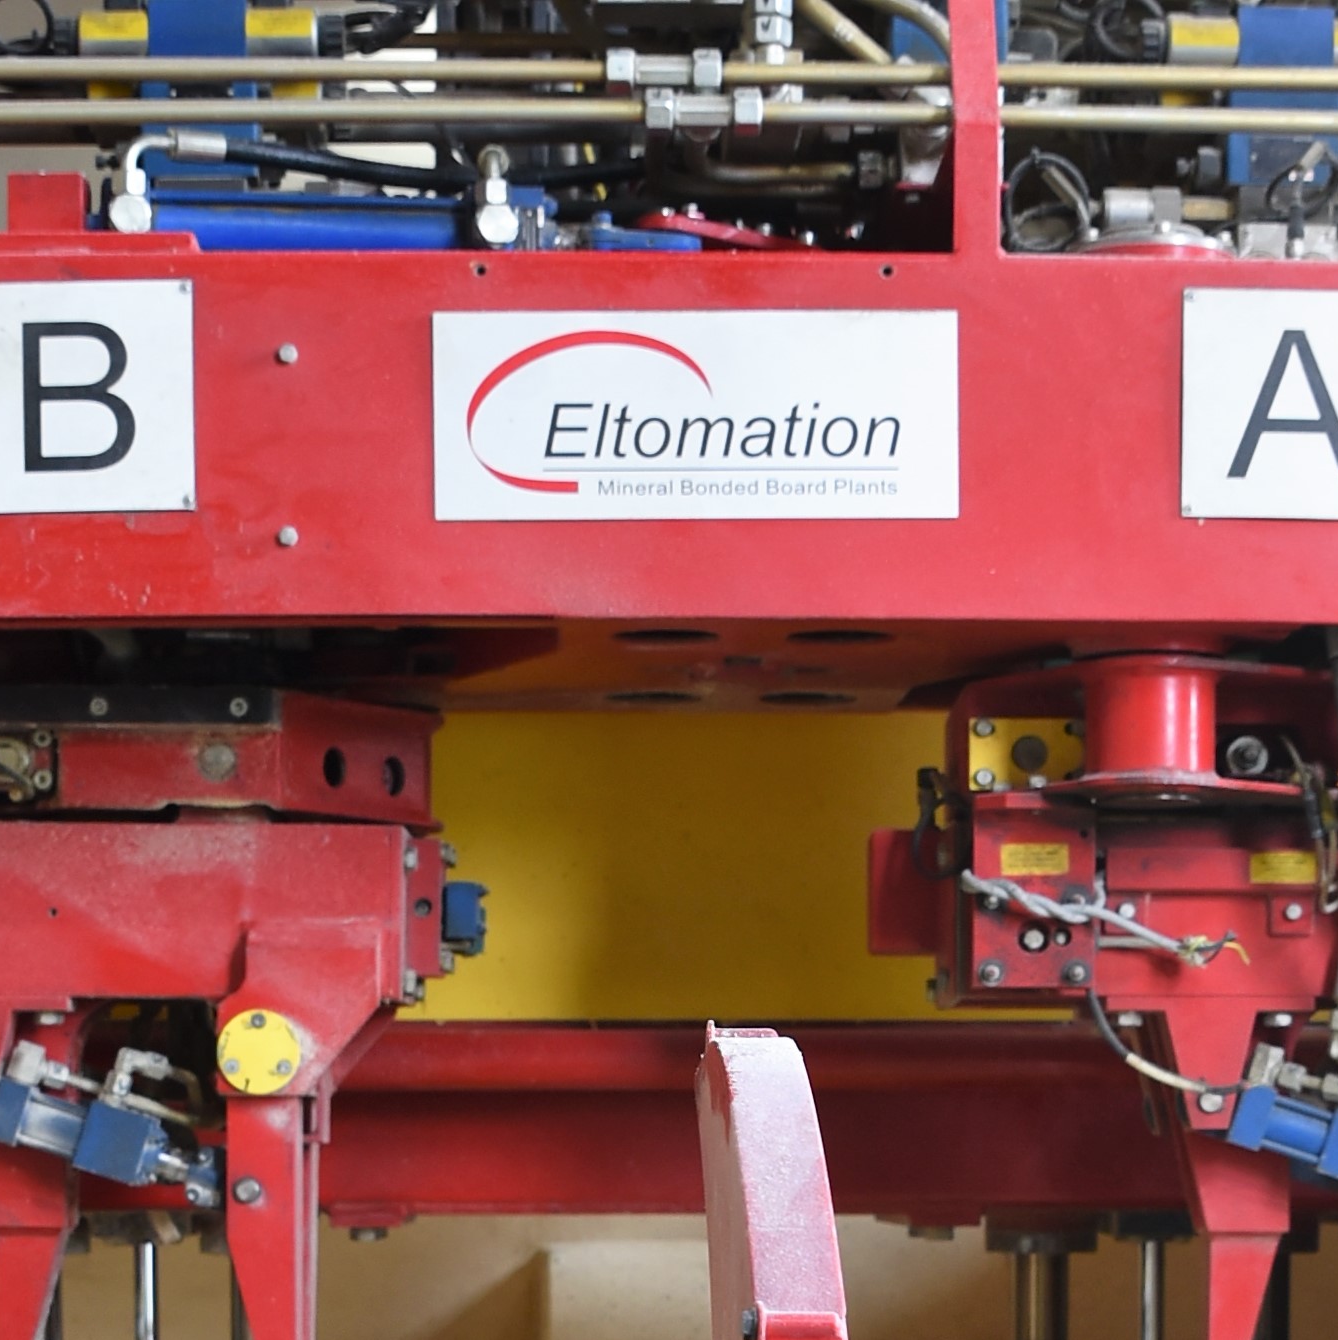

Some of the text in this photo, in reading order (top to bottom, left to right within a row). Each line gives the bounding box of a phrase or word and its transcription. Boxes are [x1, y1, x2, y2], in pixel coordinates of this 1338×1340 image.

[22, 322, 136, 473] B
[543, 401, 902, 459] Eltomation
[597, 479, 898, 496] Mineral Bonded Board Plants
